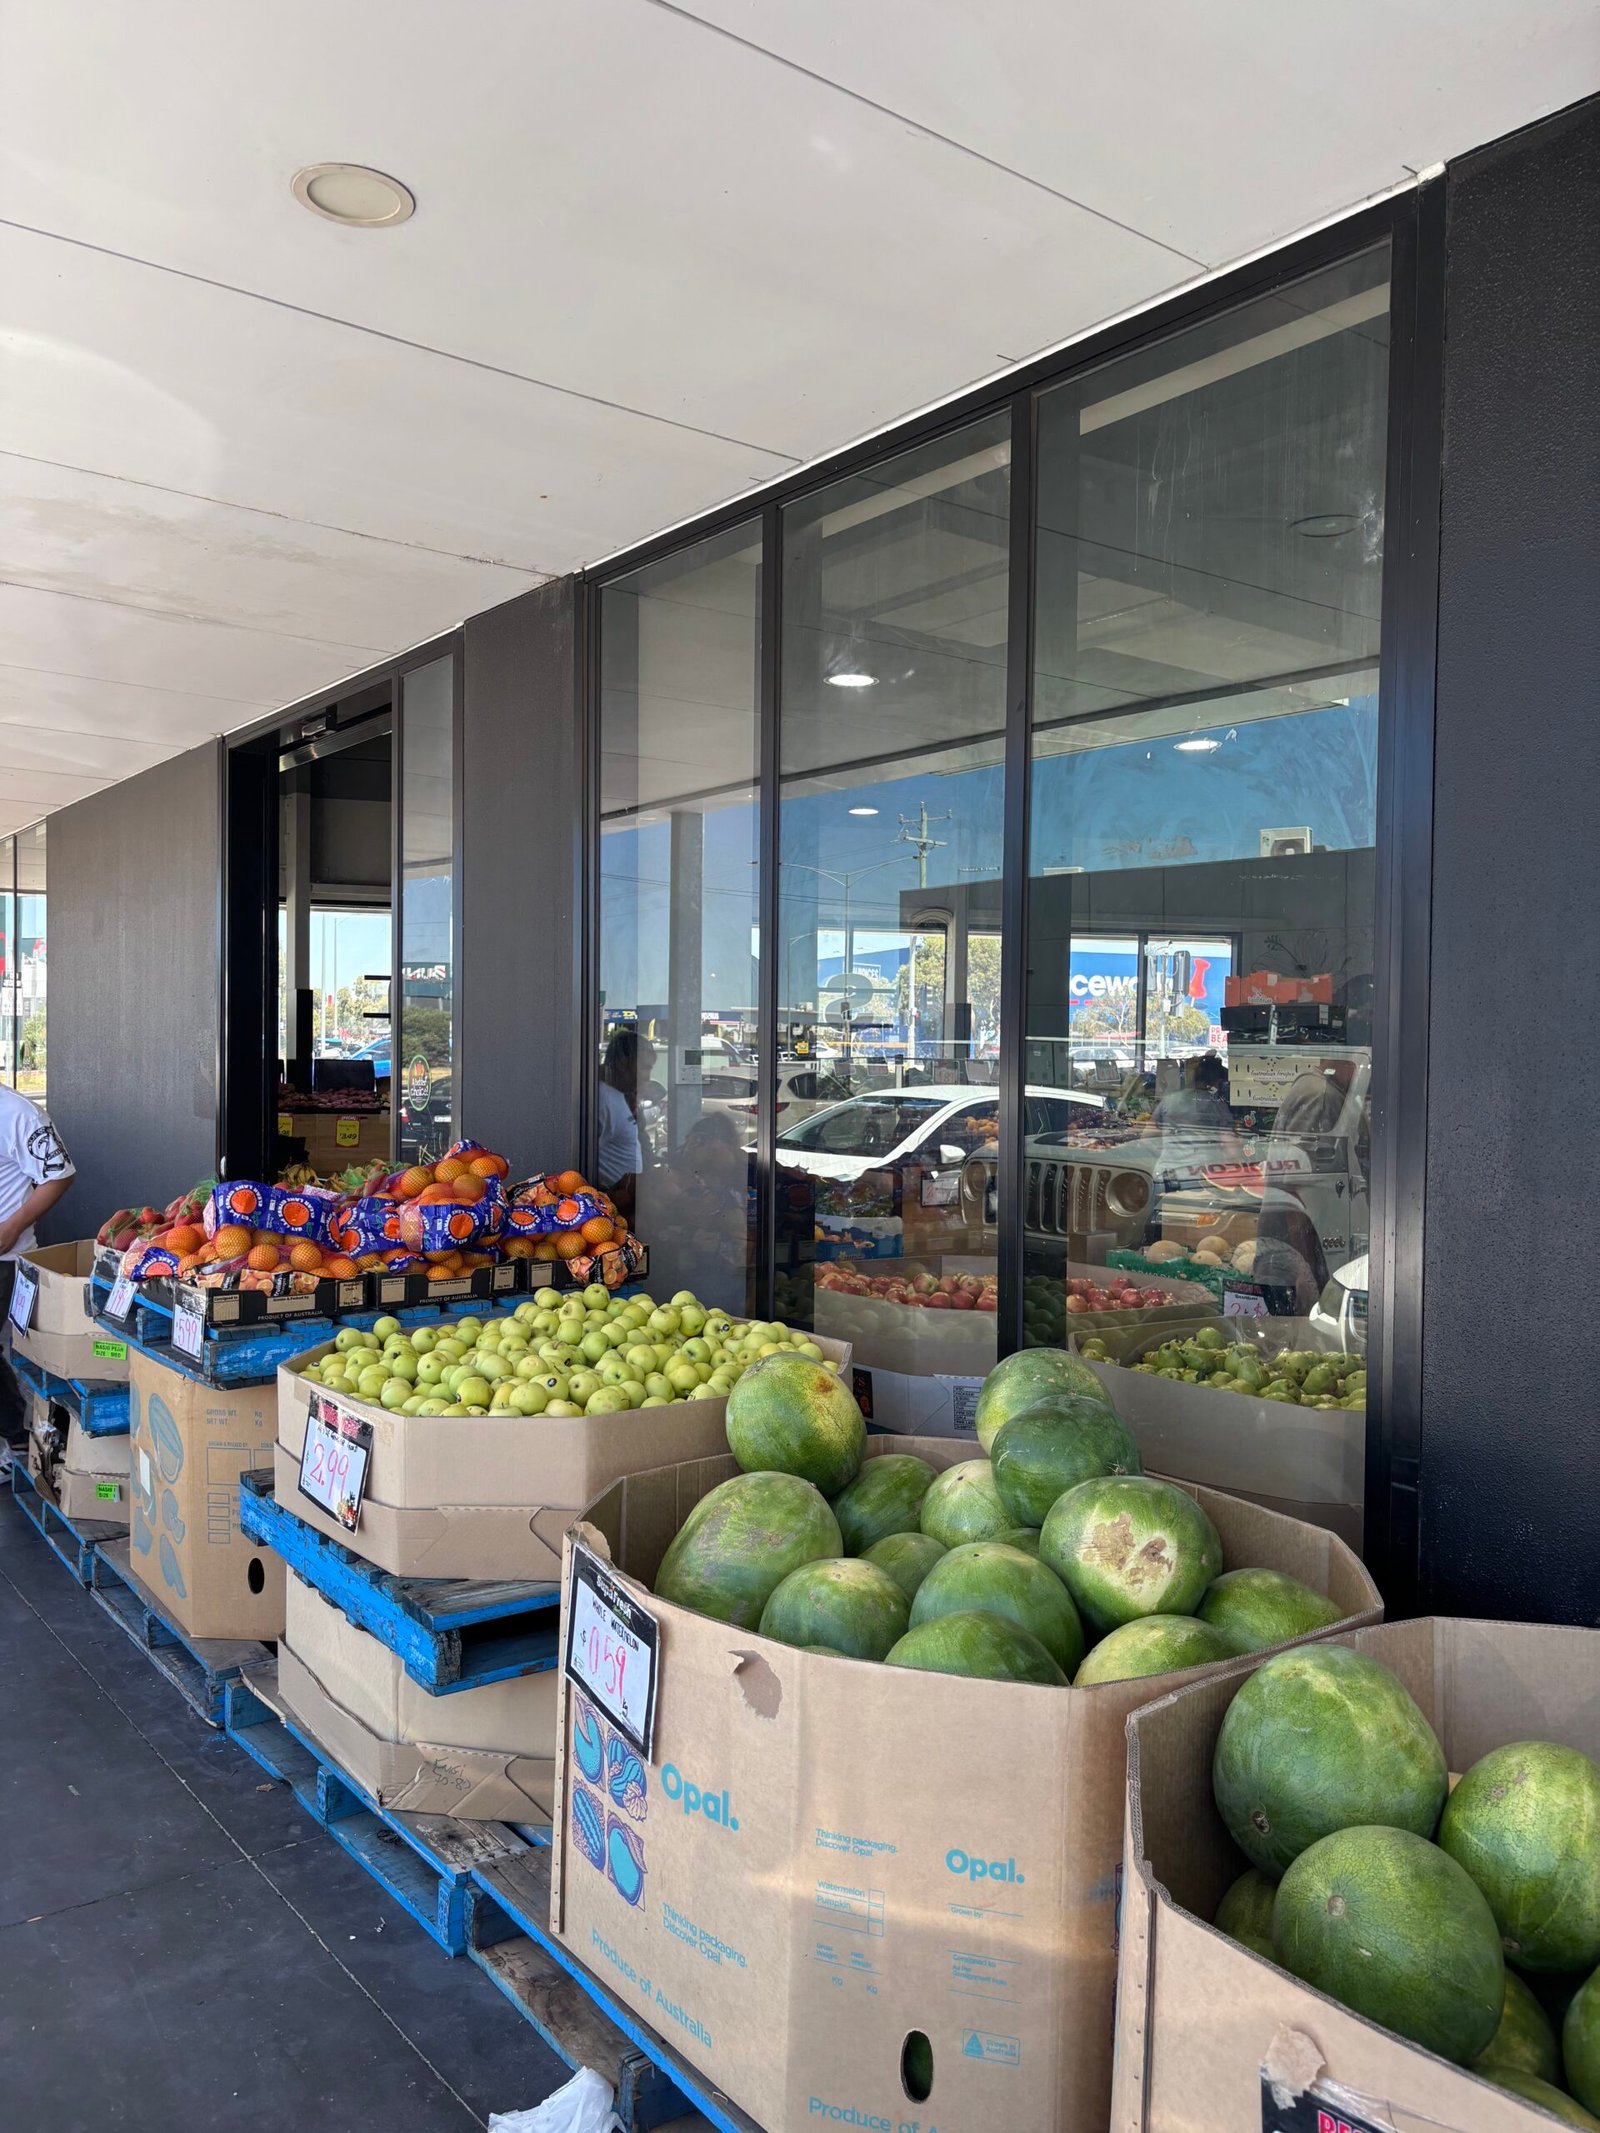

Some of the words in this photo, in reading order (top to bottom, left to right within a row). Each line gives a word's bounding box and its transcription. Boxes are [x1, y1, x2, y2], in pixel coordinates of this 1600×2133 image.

[310, 1443, 349, 1501] 2.99
[660, 1763, 740, 1832] Opal.
[816, 1828, 851, 1845] Thinking
[816, 1838, 850, 1853] Discover
[945, 1848, 1025, 1885] Opal.
[816, 1880, 865, 1897] Watermelon
[816, 1895, 851, 1910] Pumpkin
[662, 1902, 697, 1937] Thinking
[663, 1916, 698, 1949] Discover
[591, 1927, 637, 1987] Produce
[639, 1976, 652, 1998] of
[655, 1988, 713, 2049] Australia
[808, 2097, 891, 2133] Produce
